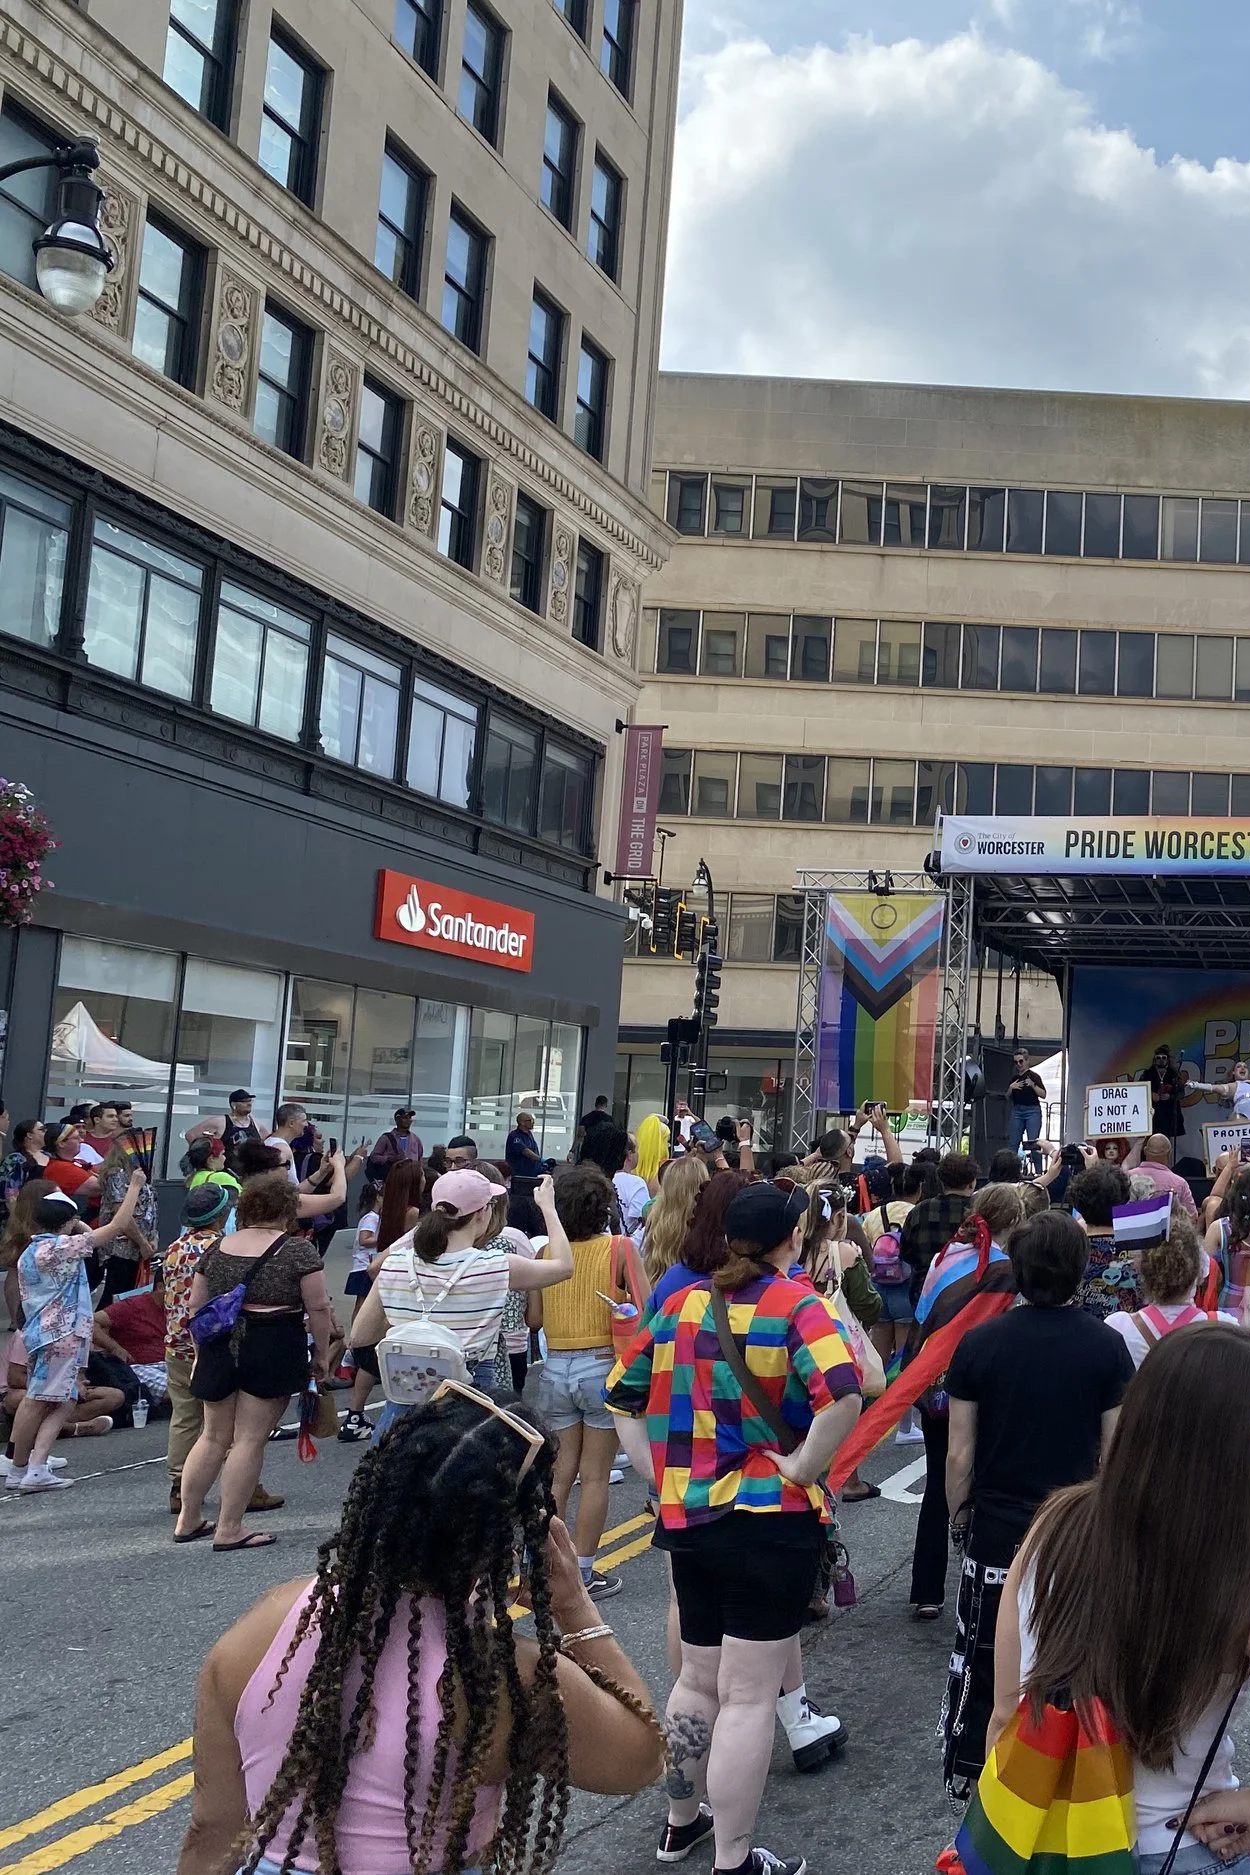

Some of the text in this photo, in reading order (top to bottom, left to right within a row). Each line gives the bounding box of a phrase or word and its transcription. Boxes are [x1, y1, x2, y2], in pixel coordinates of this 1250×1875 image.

[638, 736, 649, 793] PARK PLAZA
[635, 800, 645, 809] ON
[629, 818, 645, 867] THE GRID
[992, 832, 1006, 840] City
[1008, 832, 1016, 840] of
[978, 841, 1045, 855] WORCESTER
[1065, 831, 1136, 859] PRIDE
[426, 902, 527, 958] Santander
[1101, 1088, 1128, 1100] DRAG
[1094, 1104, 1139, 1117] IS NOT A
[1100, 1121, 1132, 1134] CRIME
